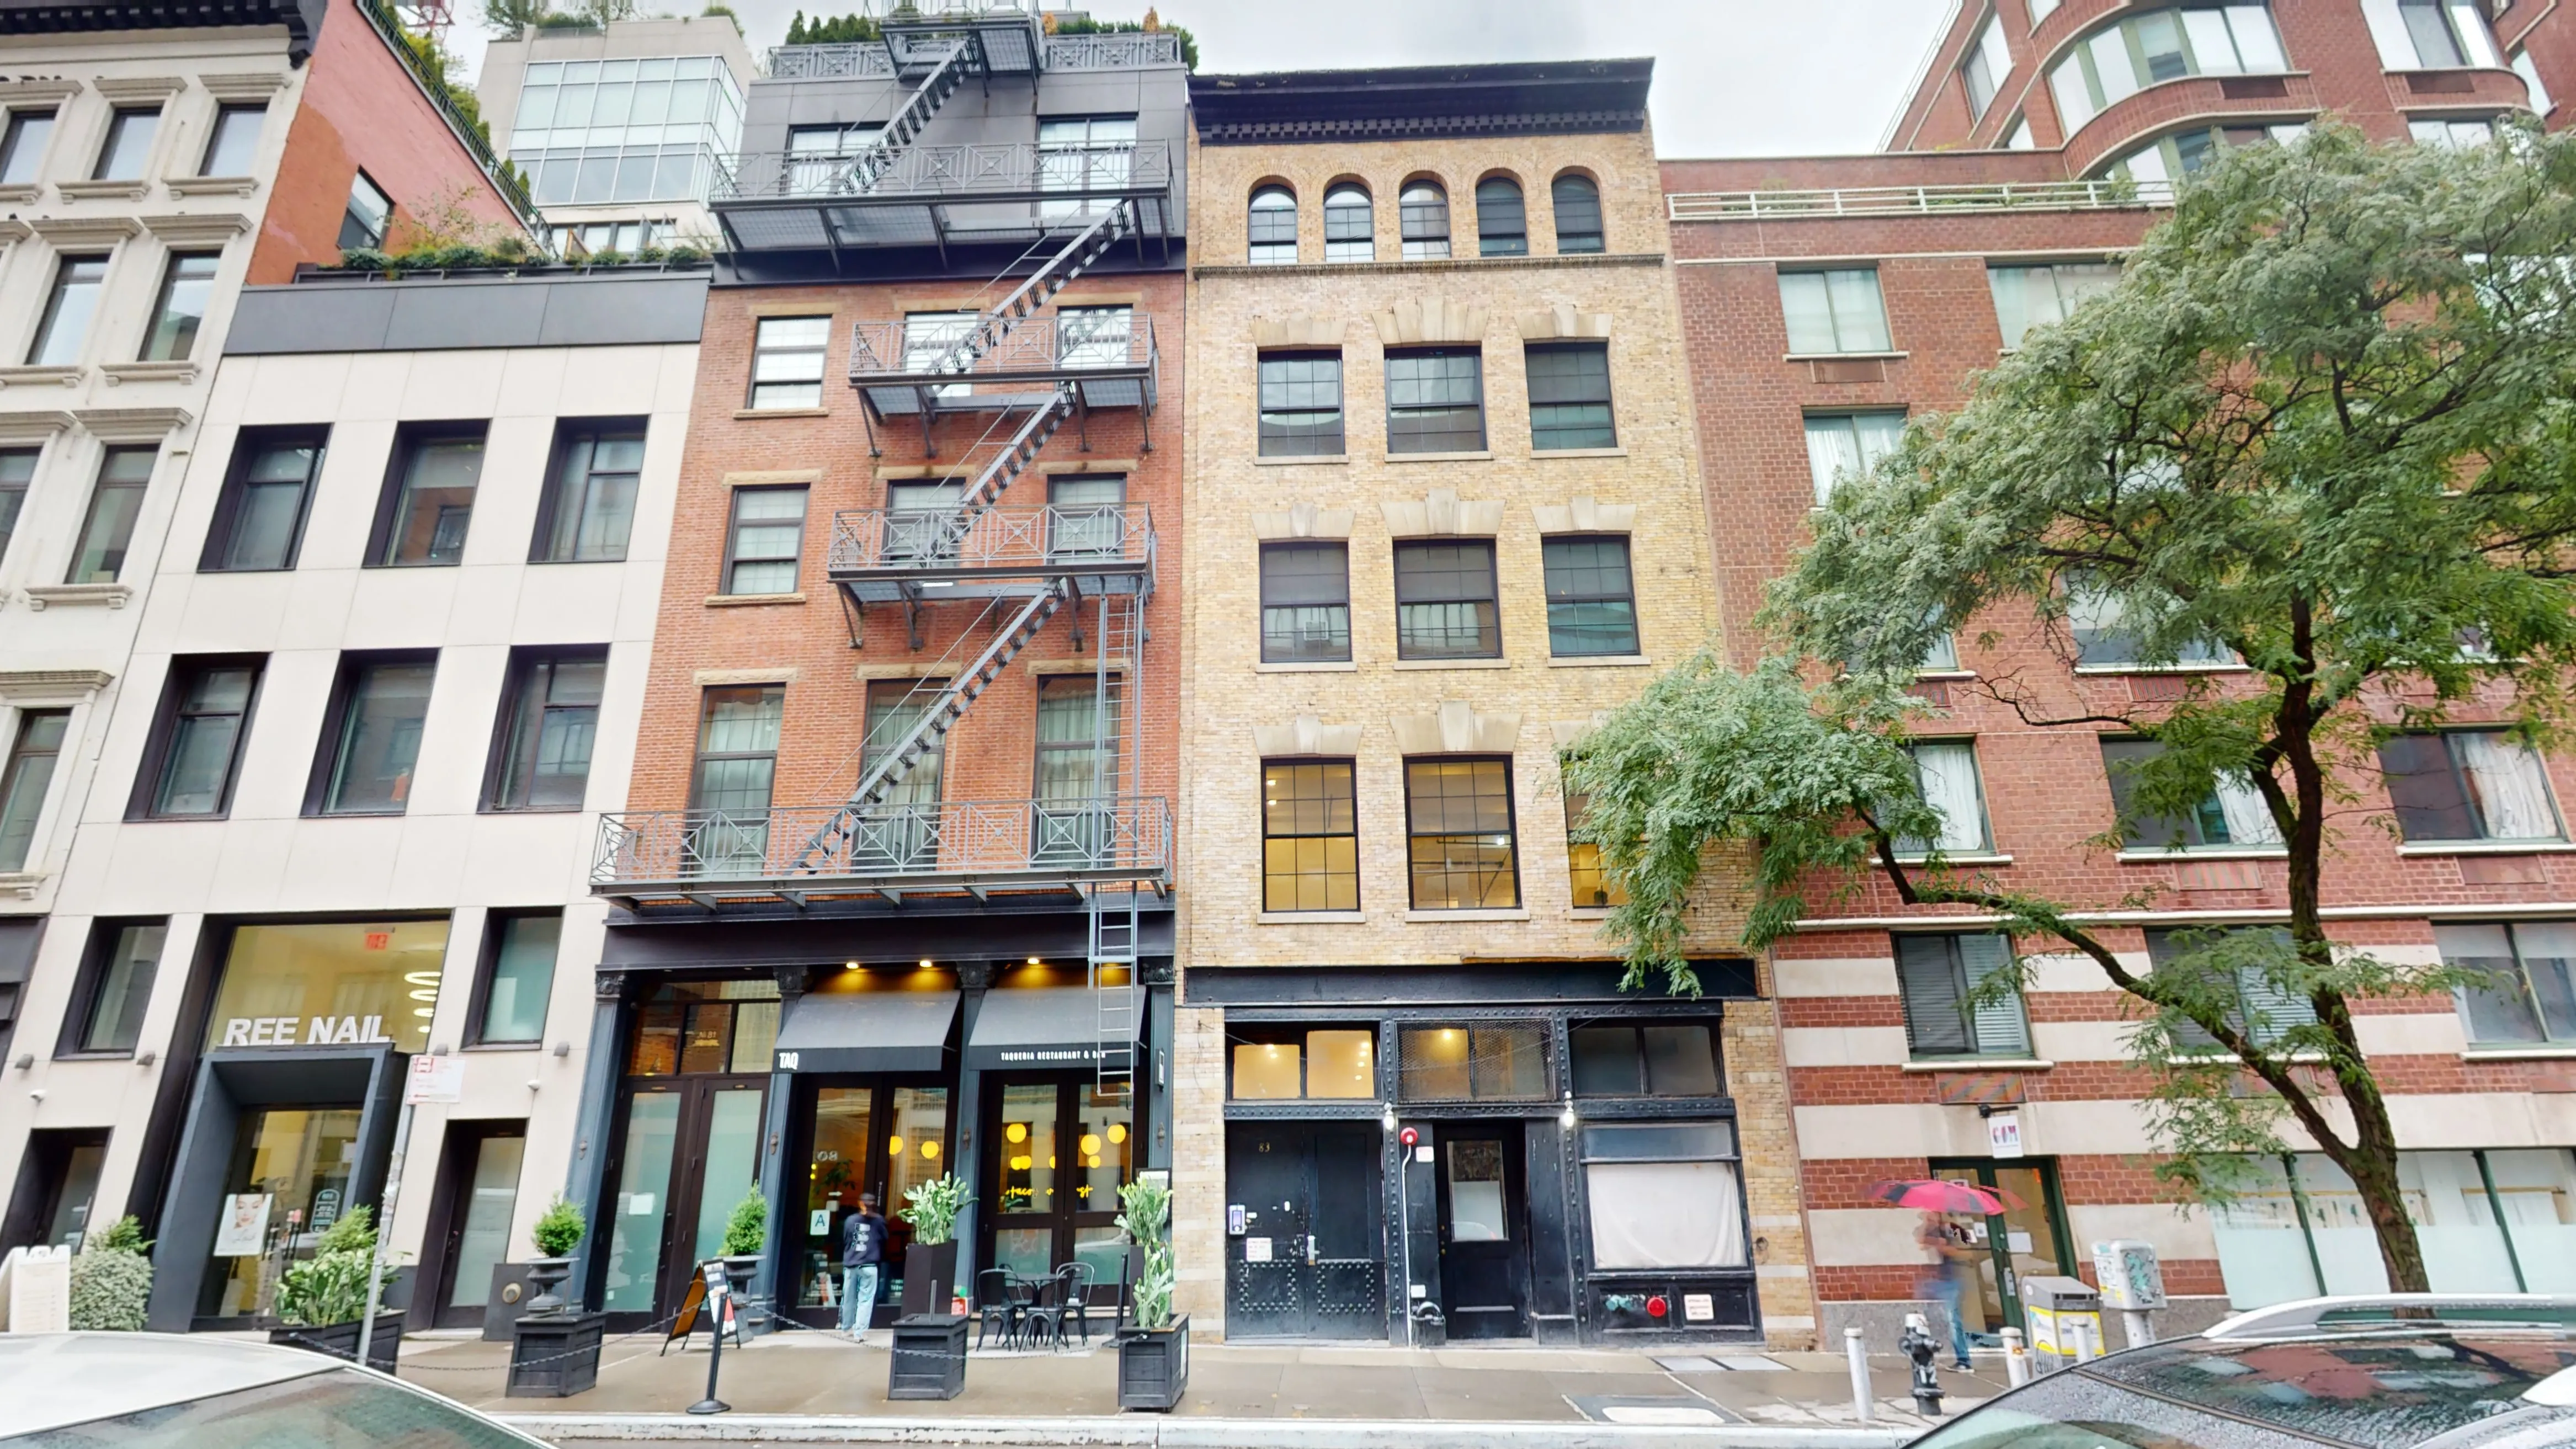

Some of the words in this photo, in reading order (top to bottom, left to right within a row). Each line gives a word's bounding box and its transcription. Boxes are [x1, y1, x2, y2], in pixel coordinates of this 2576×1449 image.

[223, 1018, 300, 1047] REE
[306, 1015, 391, 1045] NAIL
[779, 1052, 799, 1070] TAQ
[1000, 1051, 1035, 1062] TAQUERIA
[1037, 1050, 1081, 1060] RESTAURANT
[1259, 1142, 1270, 1153] 83
[815, 1214, 826, 1227] A
